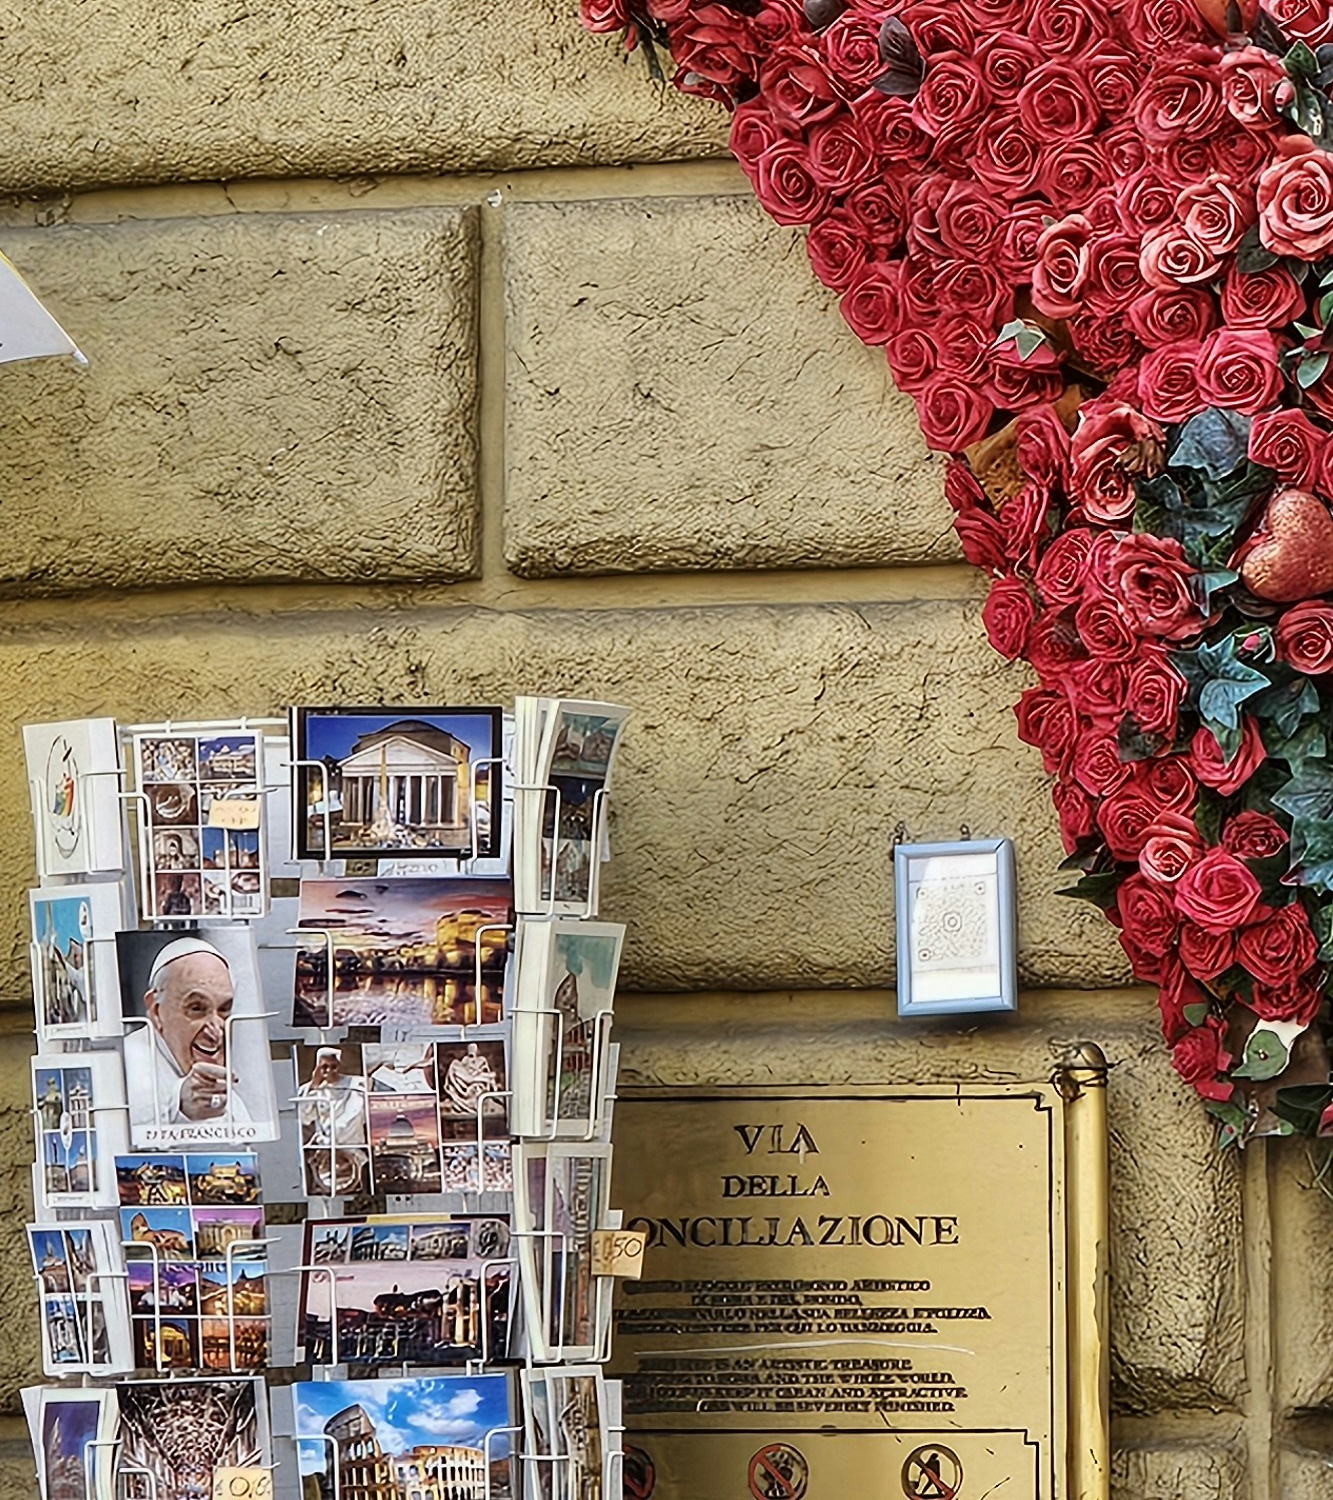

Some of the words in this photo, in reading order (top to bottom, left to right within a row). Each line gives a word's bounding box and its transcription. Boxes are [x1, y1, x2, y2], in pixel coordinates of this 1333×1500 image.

[734, 1124, 819, 1154] VIA
[721, 1175, 830, 1197] DELLA
[626, 1215, 959, 1247] ONCILIAZIONE
